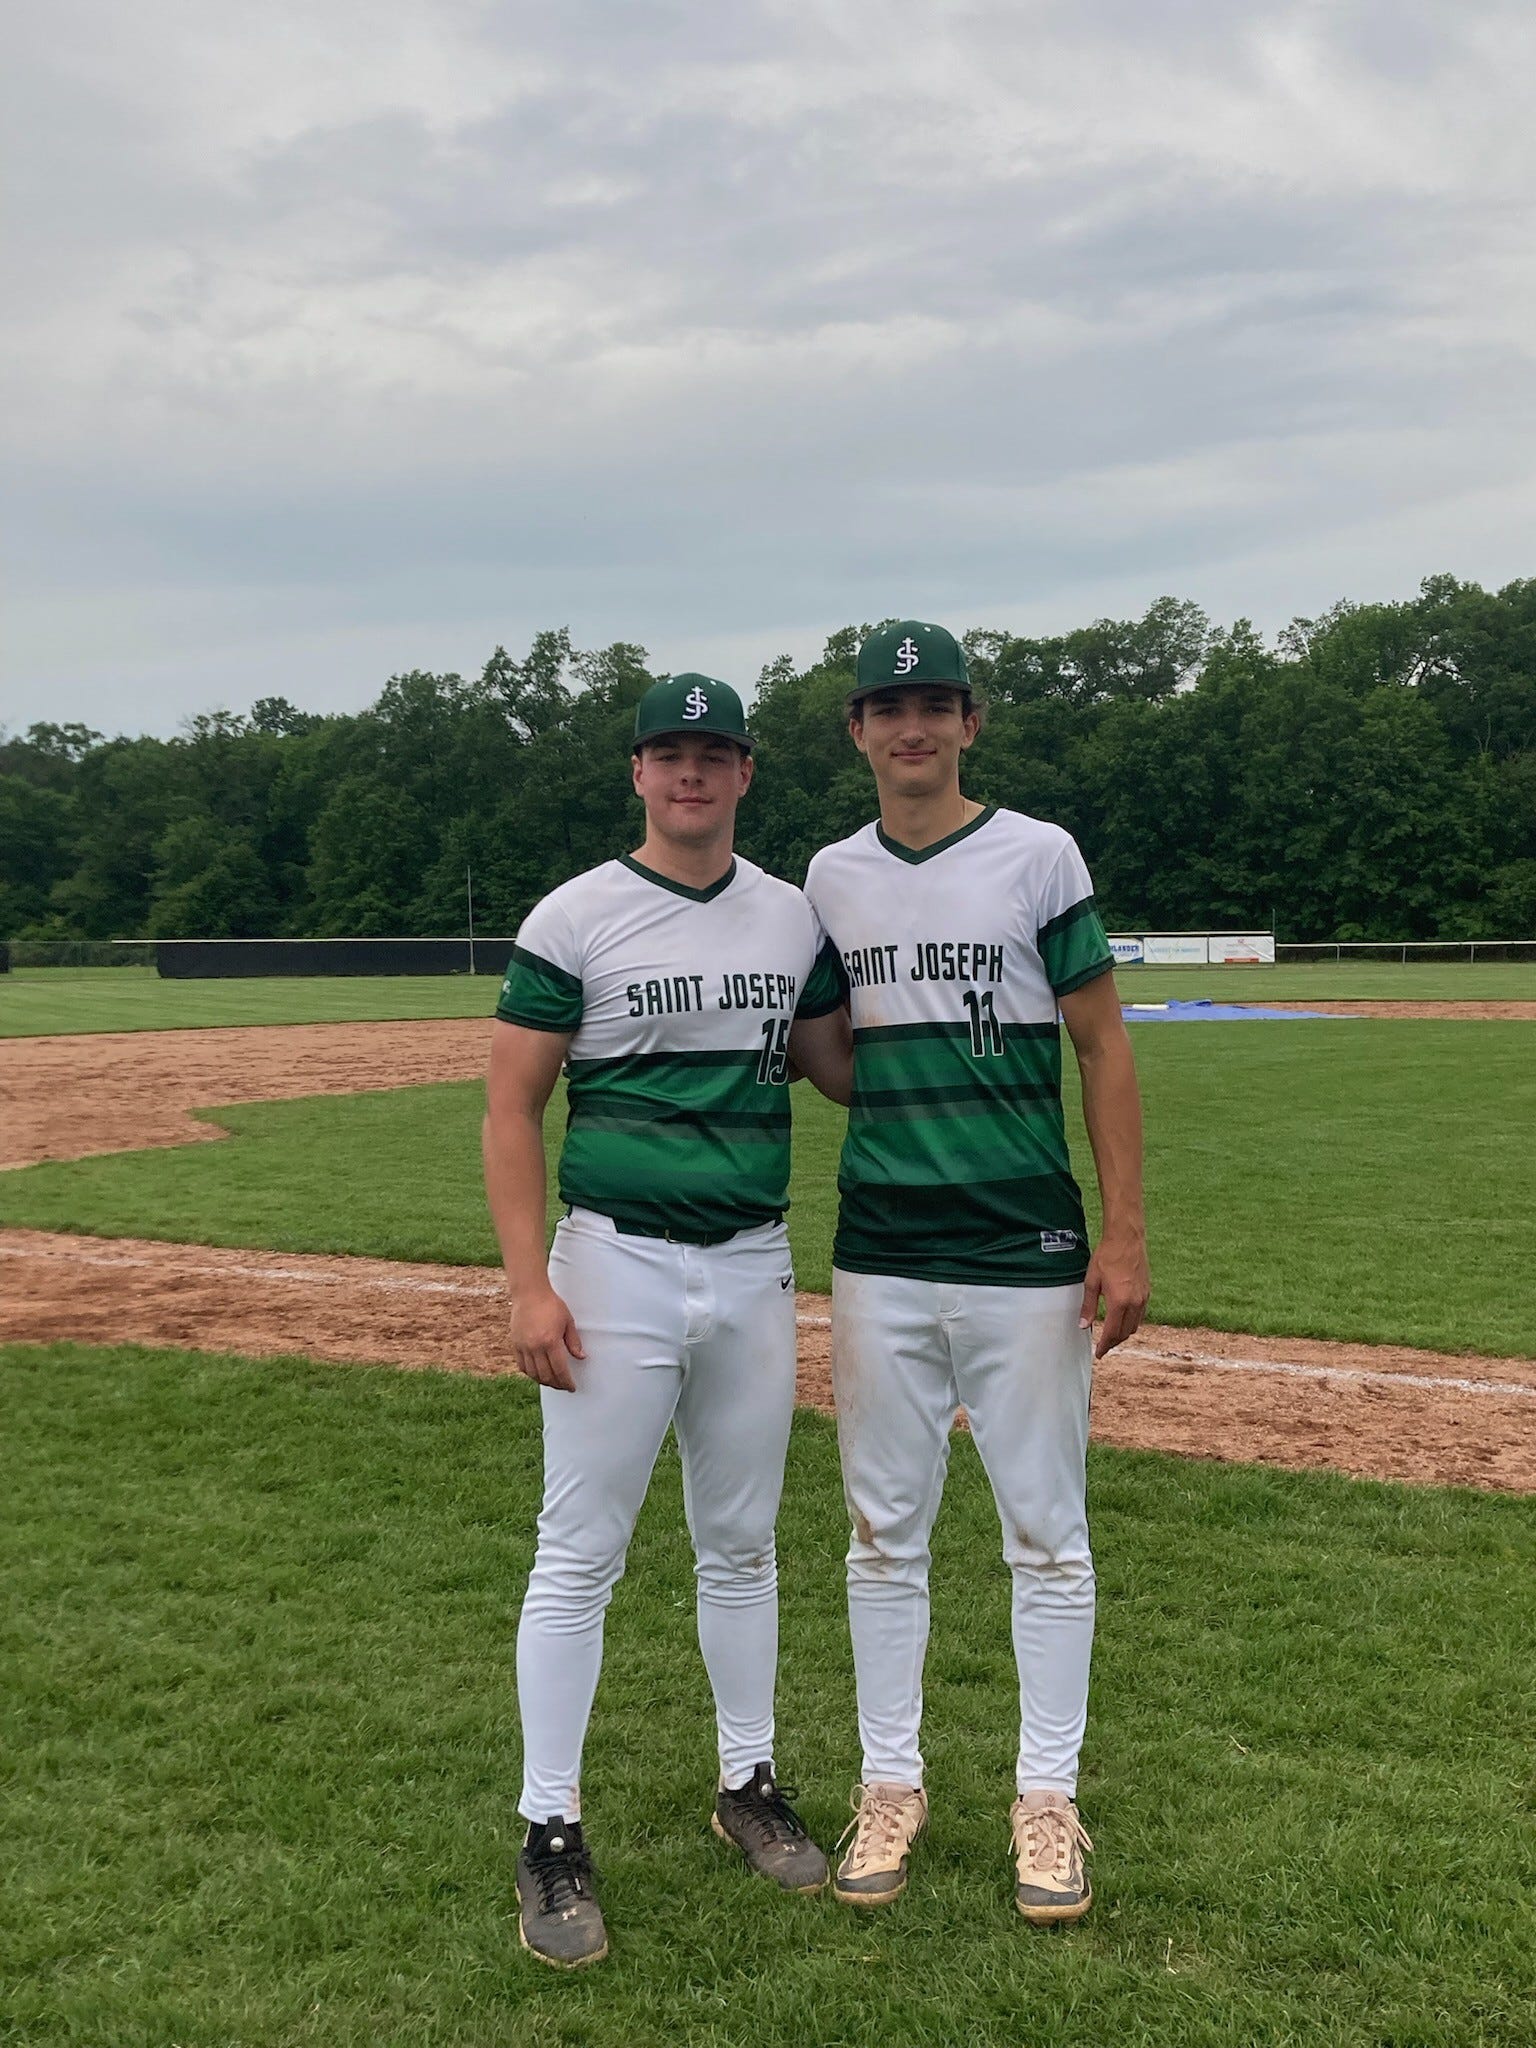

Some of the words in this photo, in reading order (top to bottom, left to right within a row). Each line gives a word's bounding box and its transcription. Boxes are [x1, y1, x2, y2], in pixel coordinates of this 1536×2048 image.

[844, 945, 898, 988] SAINT
[911, 942, 1004, 983] JOSEPH
[626, 975, 703, 1018] SAINT
[718, 973, 796, 1012] JOSEPH
[962, 990, 1004, 1058] 11
[756, 1018, 790, 1086] 15
